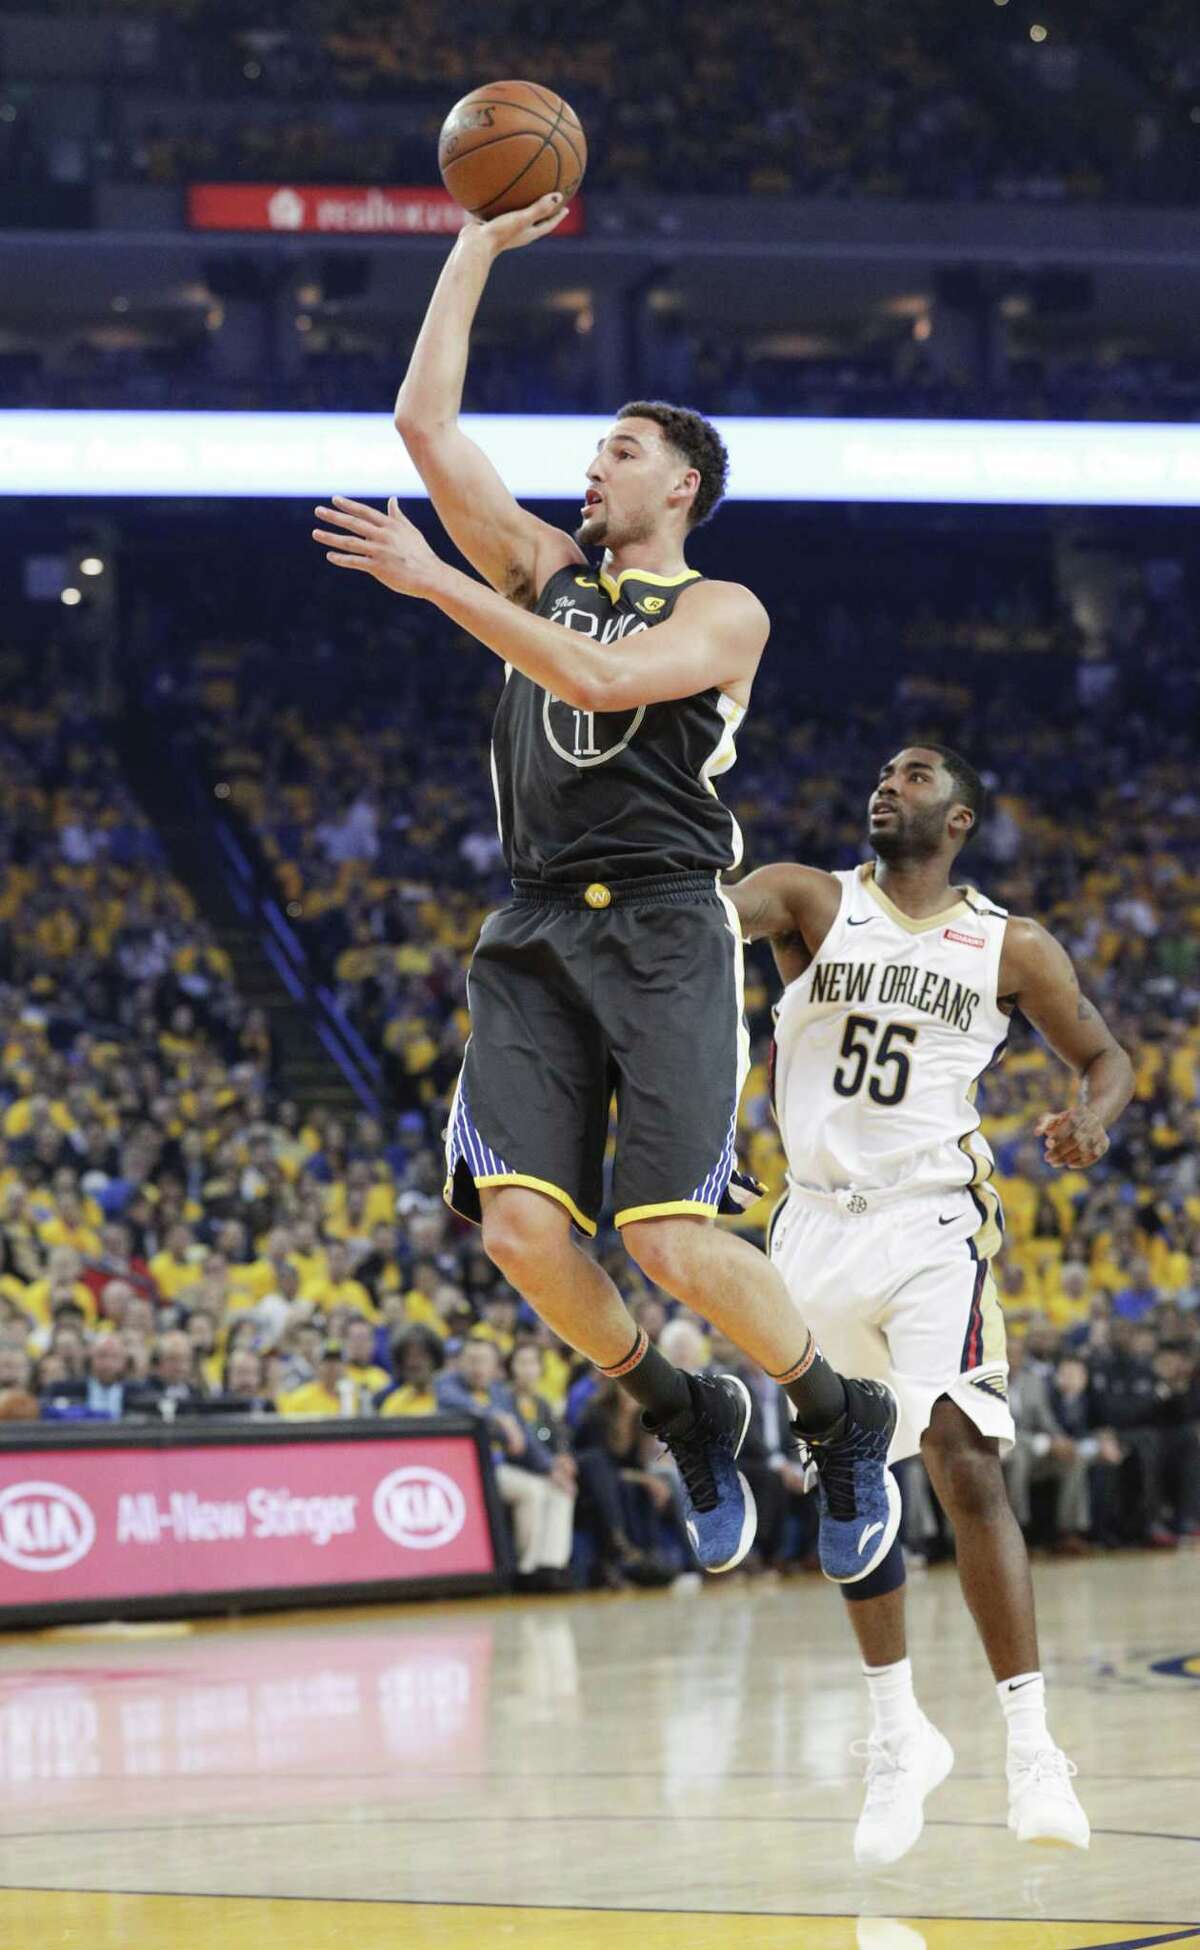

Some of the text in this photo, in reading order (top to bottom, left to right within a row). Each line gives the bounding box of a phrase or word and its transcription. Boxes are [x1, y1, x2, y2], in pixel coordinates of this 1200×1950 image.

[552, 596, 575, 611] The
[572, 710, 601, 755] 11
[809, 963, 980, 1032] NEW ORLEANS
[833, 1014, 918, 1106] 55
[1, 1501, 79, 1552] KIA
[117, 1488, 356, 1545] All-New Stinger
[391, 1485, 448, 1529] KIA
